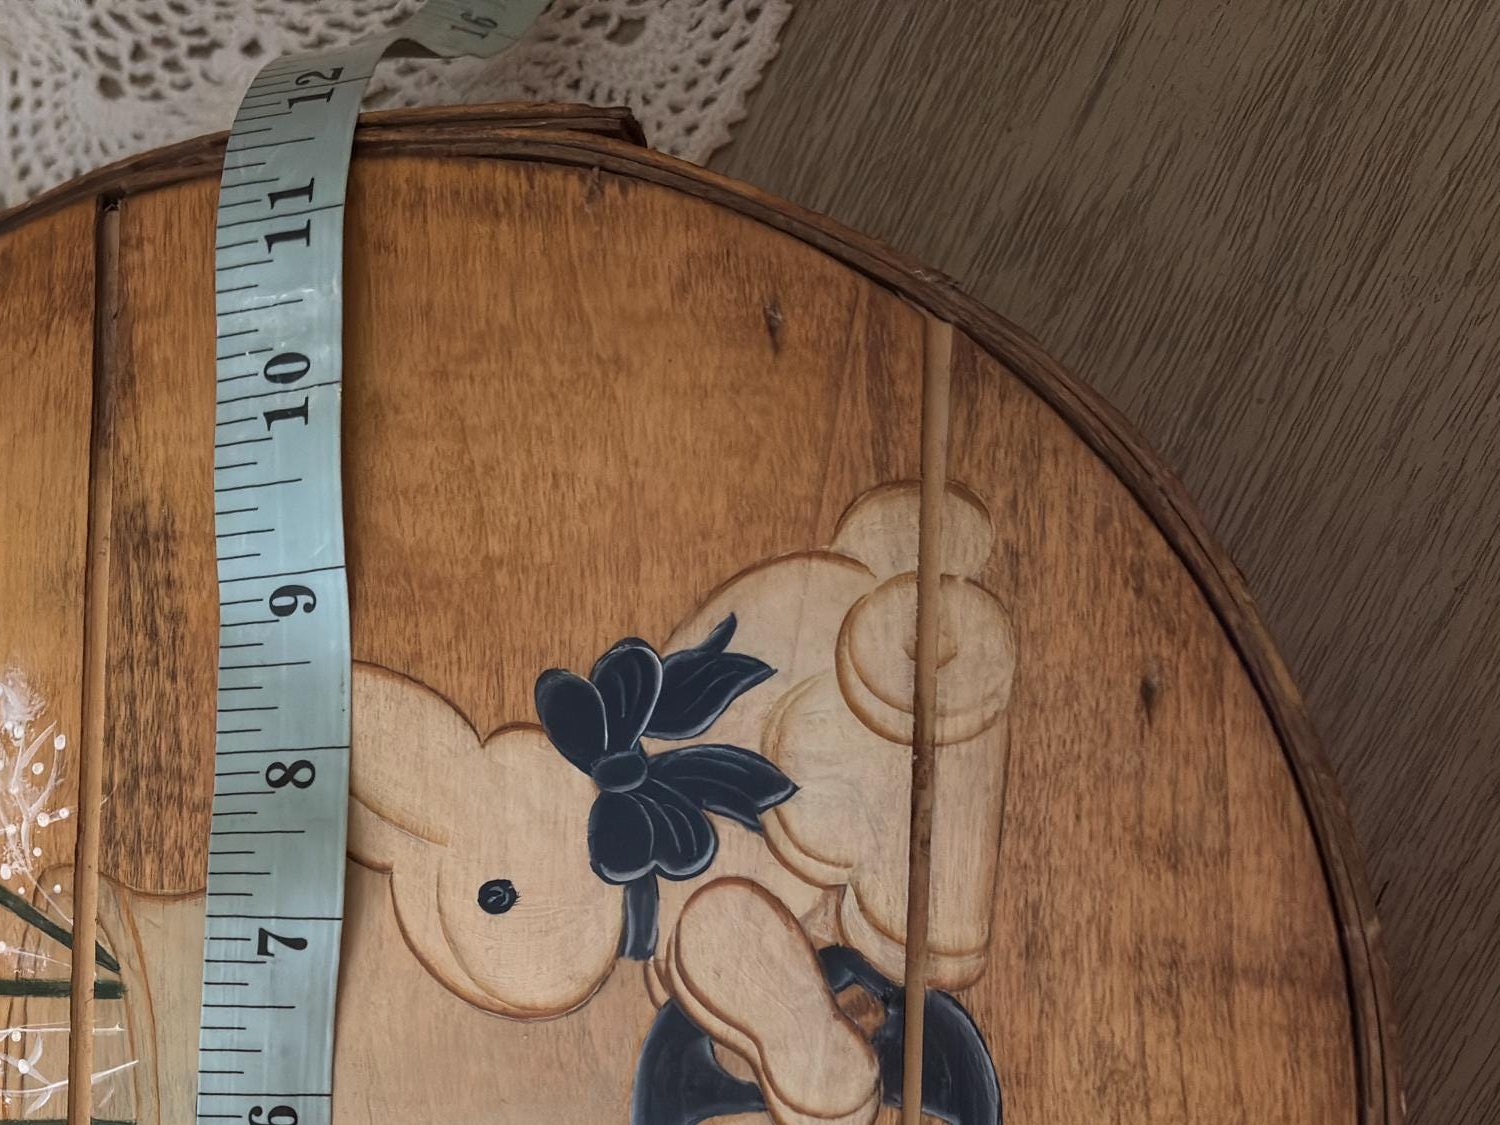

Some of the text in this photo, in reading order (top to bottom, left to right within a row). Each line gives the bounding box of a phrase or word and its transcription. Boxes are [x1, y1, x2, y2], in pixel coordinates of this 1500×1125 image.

[287, 66, 344, 109] 12
[264, 177, 315, 253] 11
[263, 351, 311, 432] 10
[268, 584, 317, 617] 9
[265, 759, 316, 789] 8
[256, 927, 308, 958] 7
